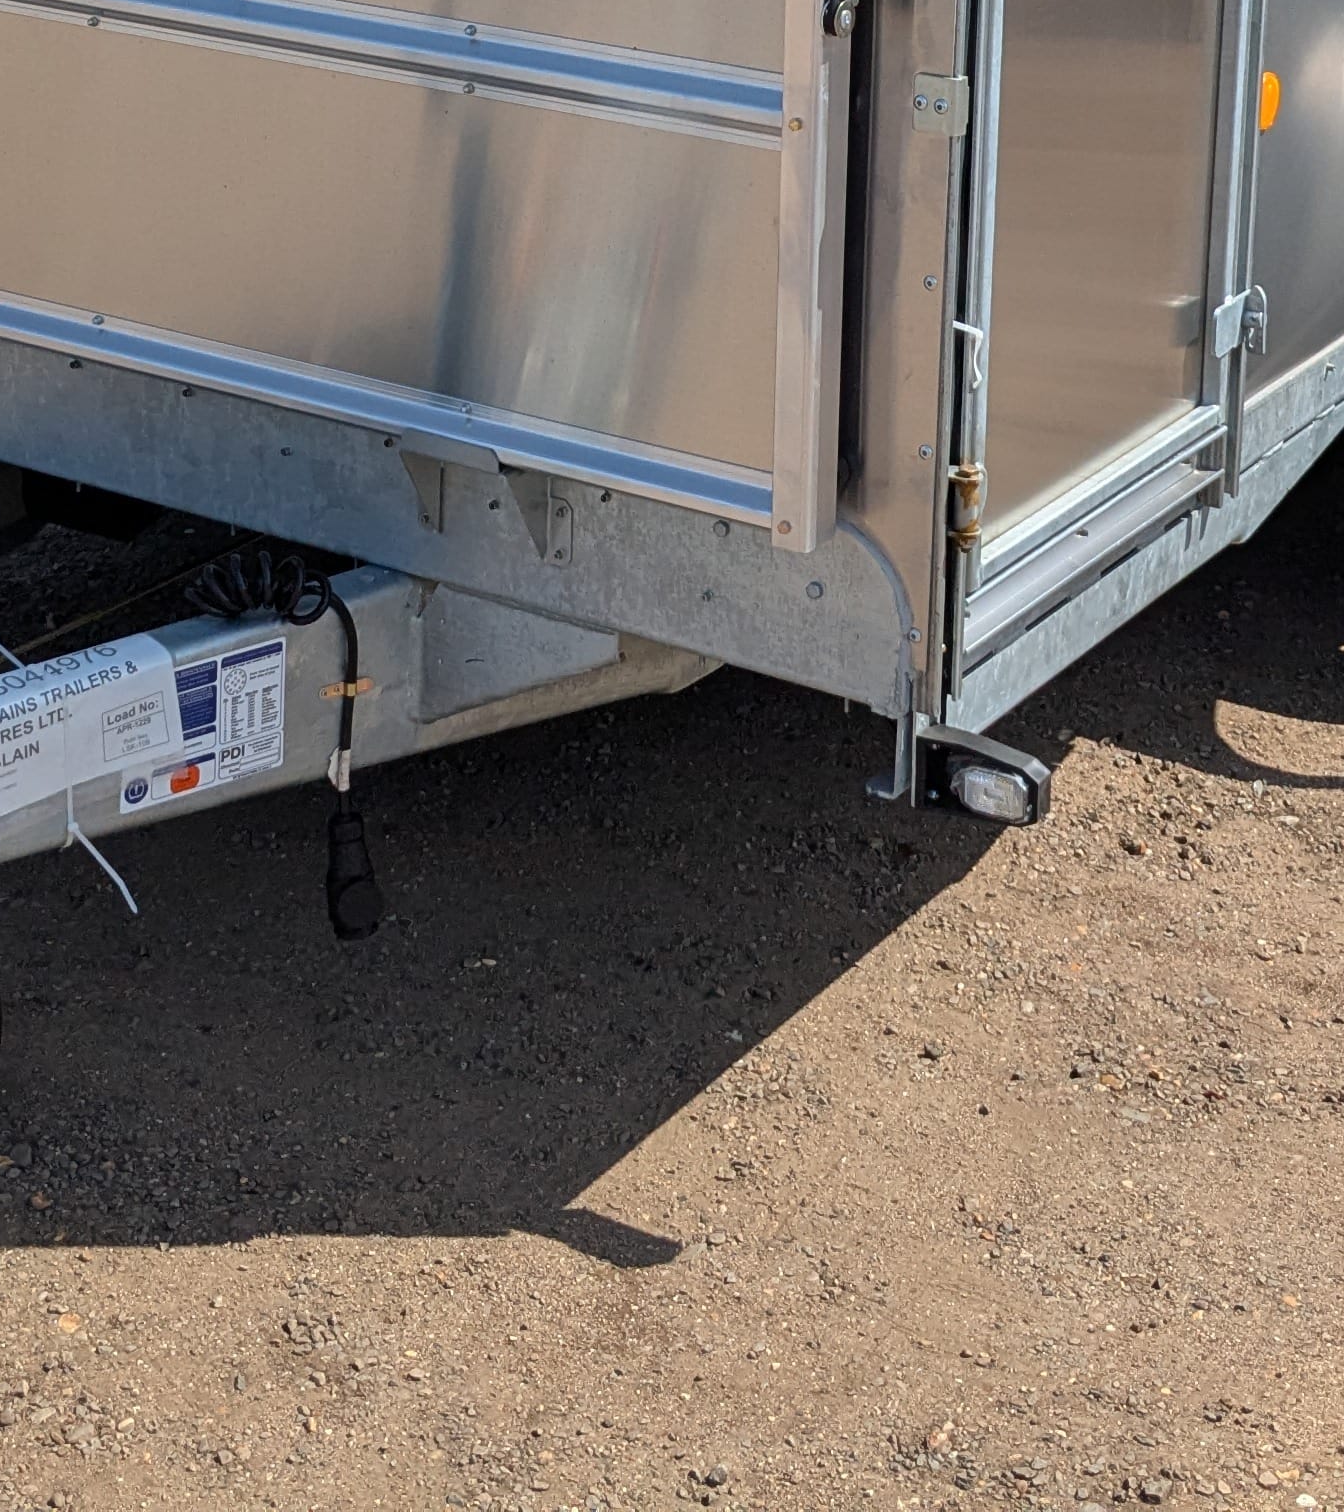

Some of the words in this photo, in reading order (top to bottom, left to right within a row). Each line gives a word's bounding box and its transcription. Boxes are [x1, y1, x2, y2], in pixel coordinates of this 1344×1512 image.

[40, 666, 122, 708] TRAILERS
[125, 660, 138, 675] &
[107, 706, 136, 726] Load
[139, 699, 159, 714] No:
[221, 744, 245, 763] PDI
